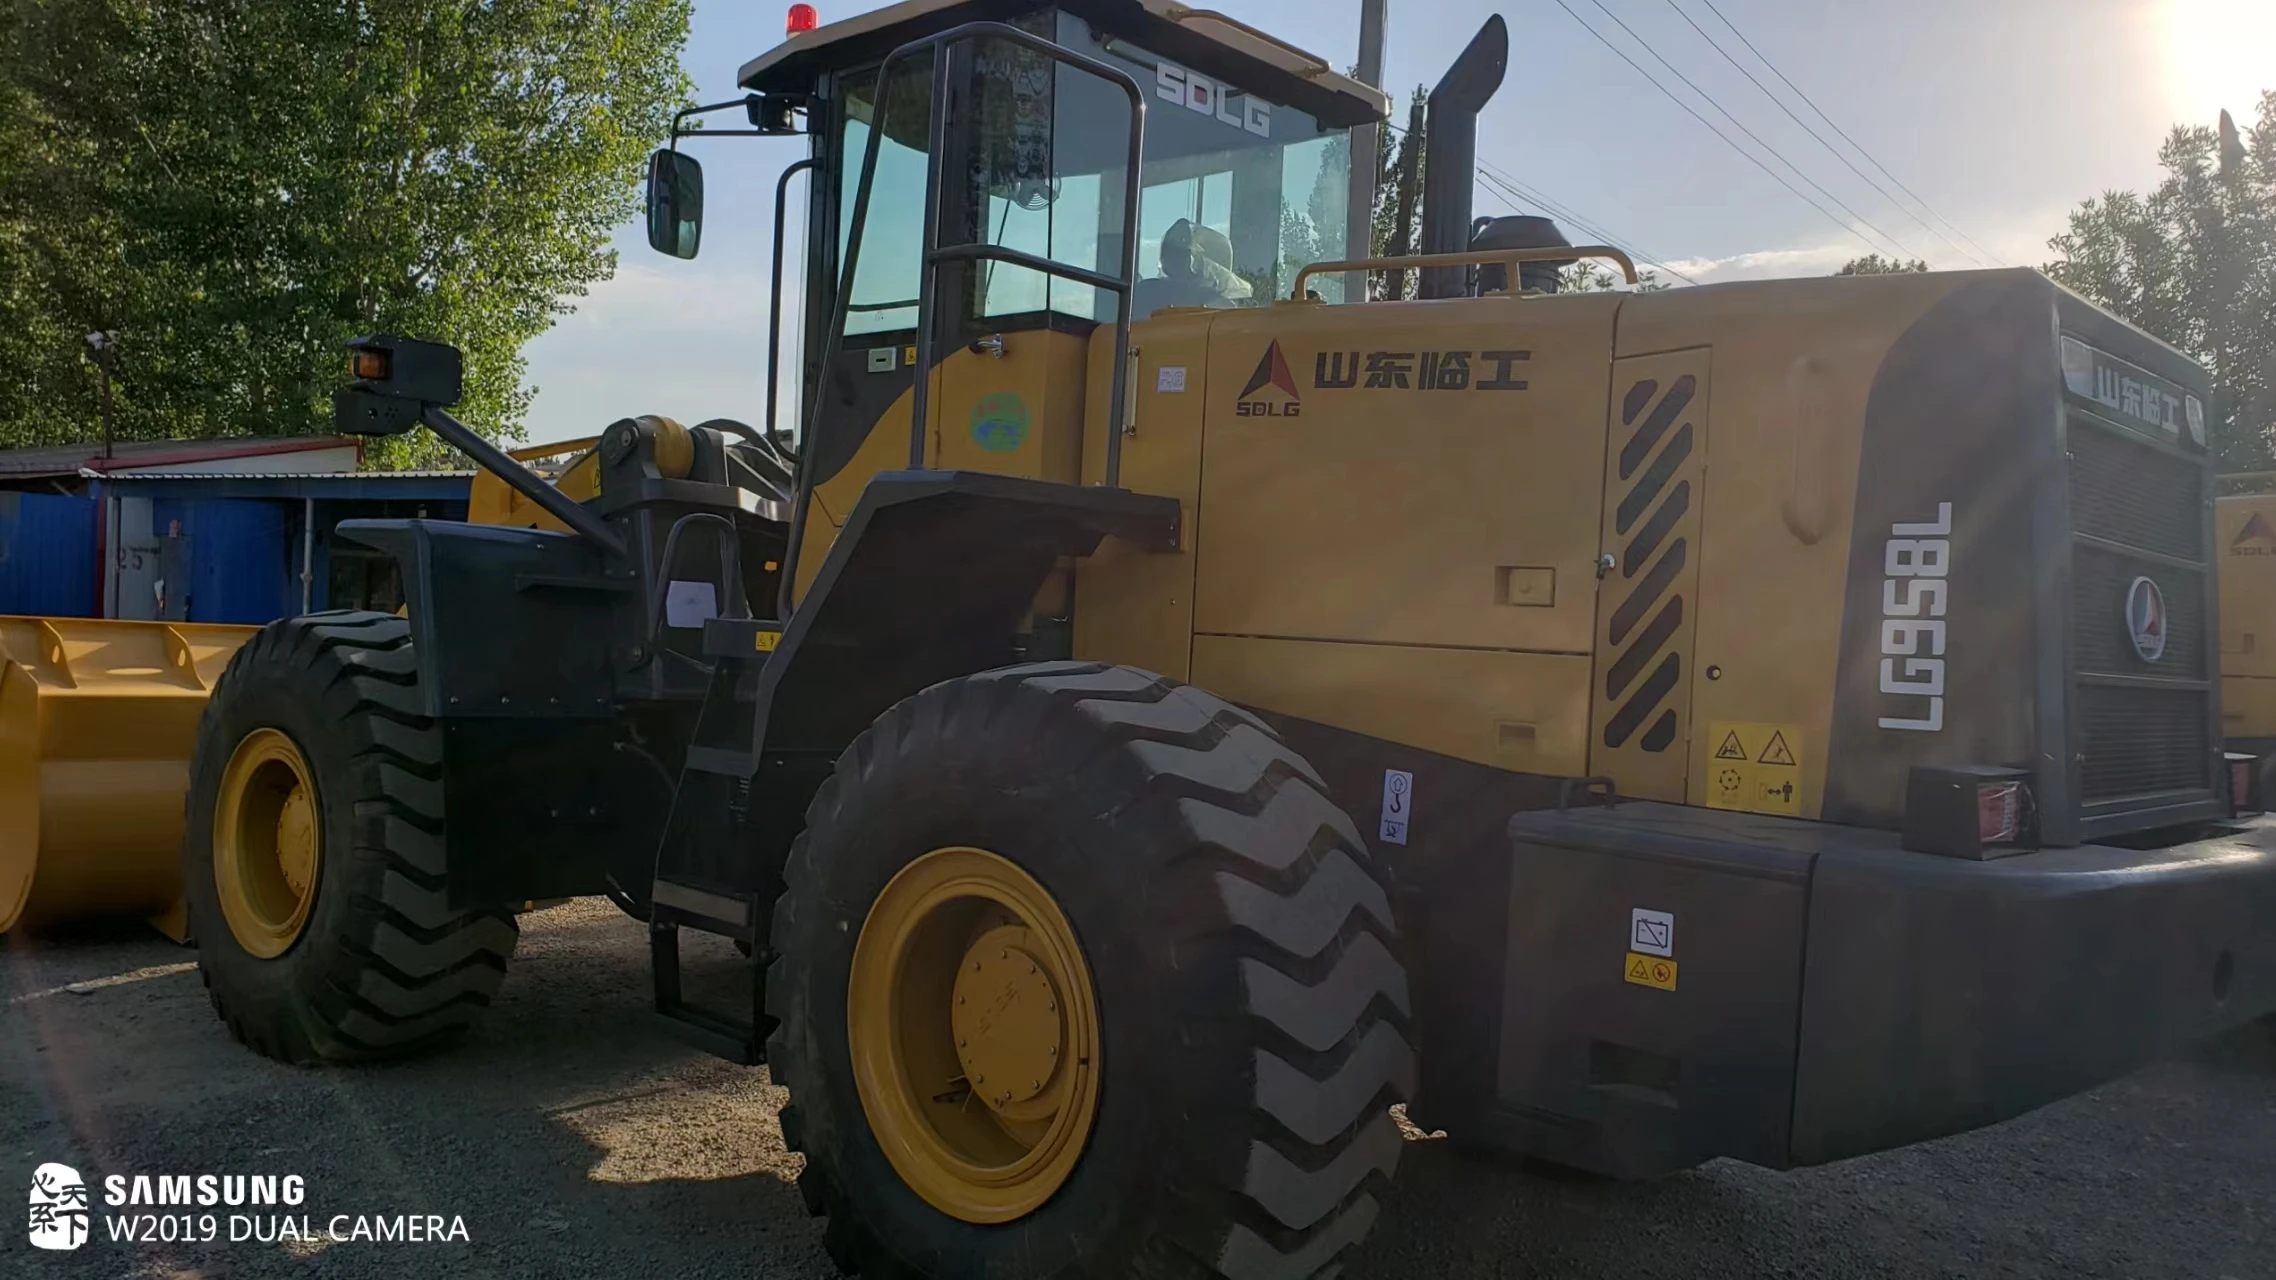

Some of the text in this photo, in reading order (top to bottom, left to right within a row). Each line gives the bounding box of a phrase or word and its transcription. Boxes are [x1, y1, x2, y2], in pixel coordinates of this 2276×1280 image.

[1156, 61, 1270, 138] SDLG
[1314, 351, 1532, 390] 山东临工
[2097, 365, 2180, 434] 山东临工
[1236, 402, 1300, 417] SDLG
[1878, 501, 1952, 731] LG958L
